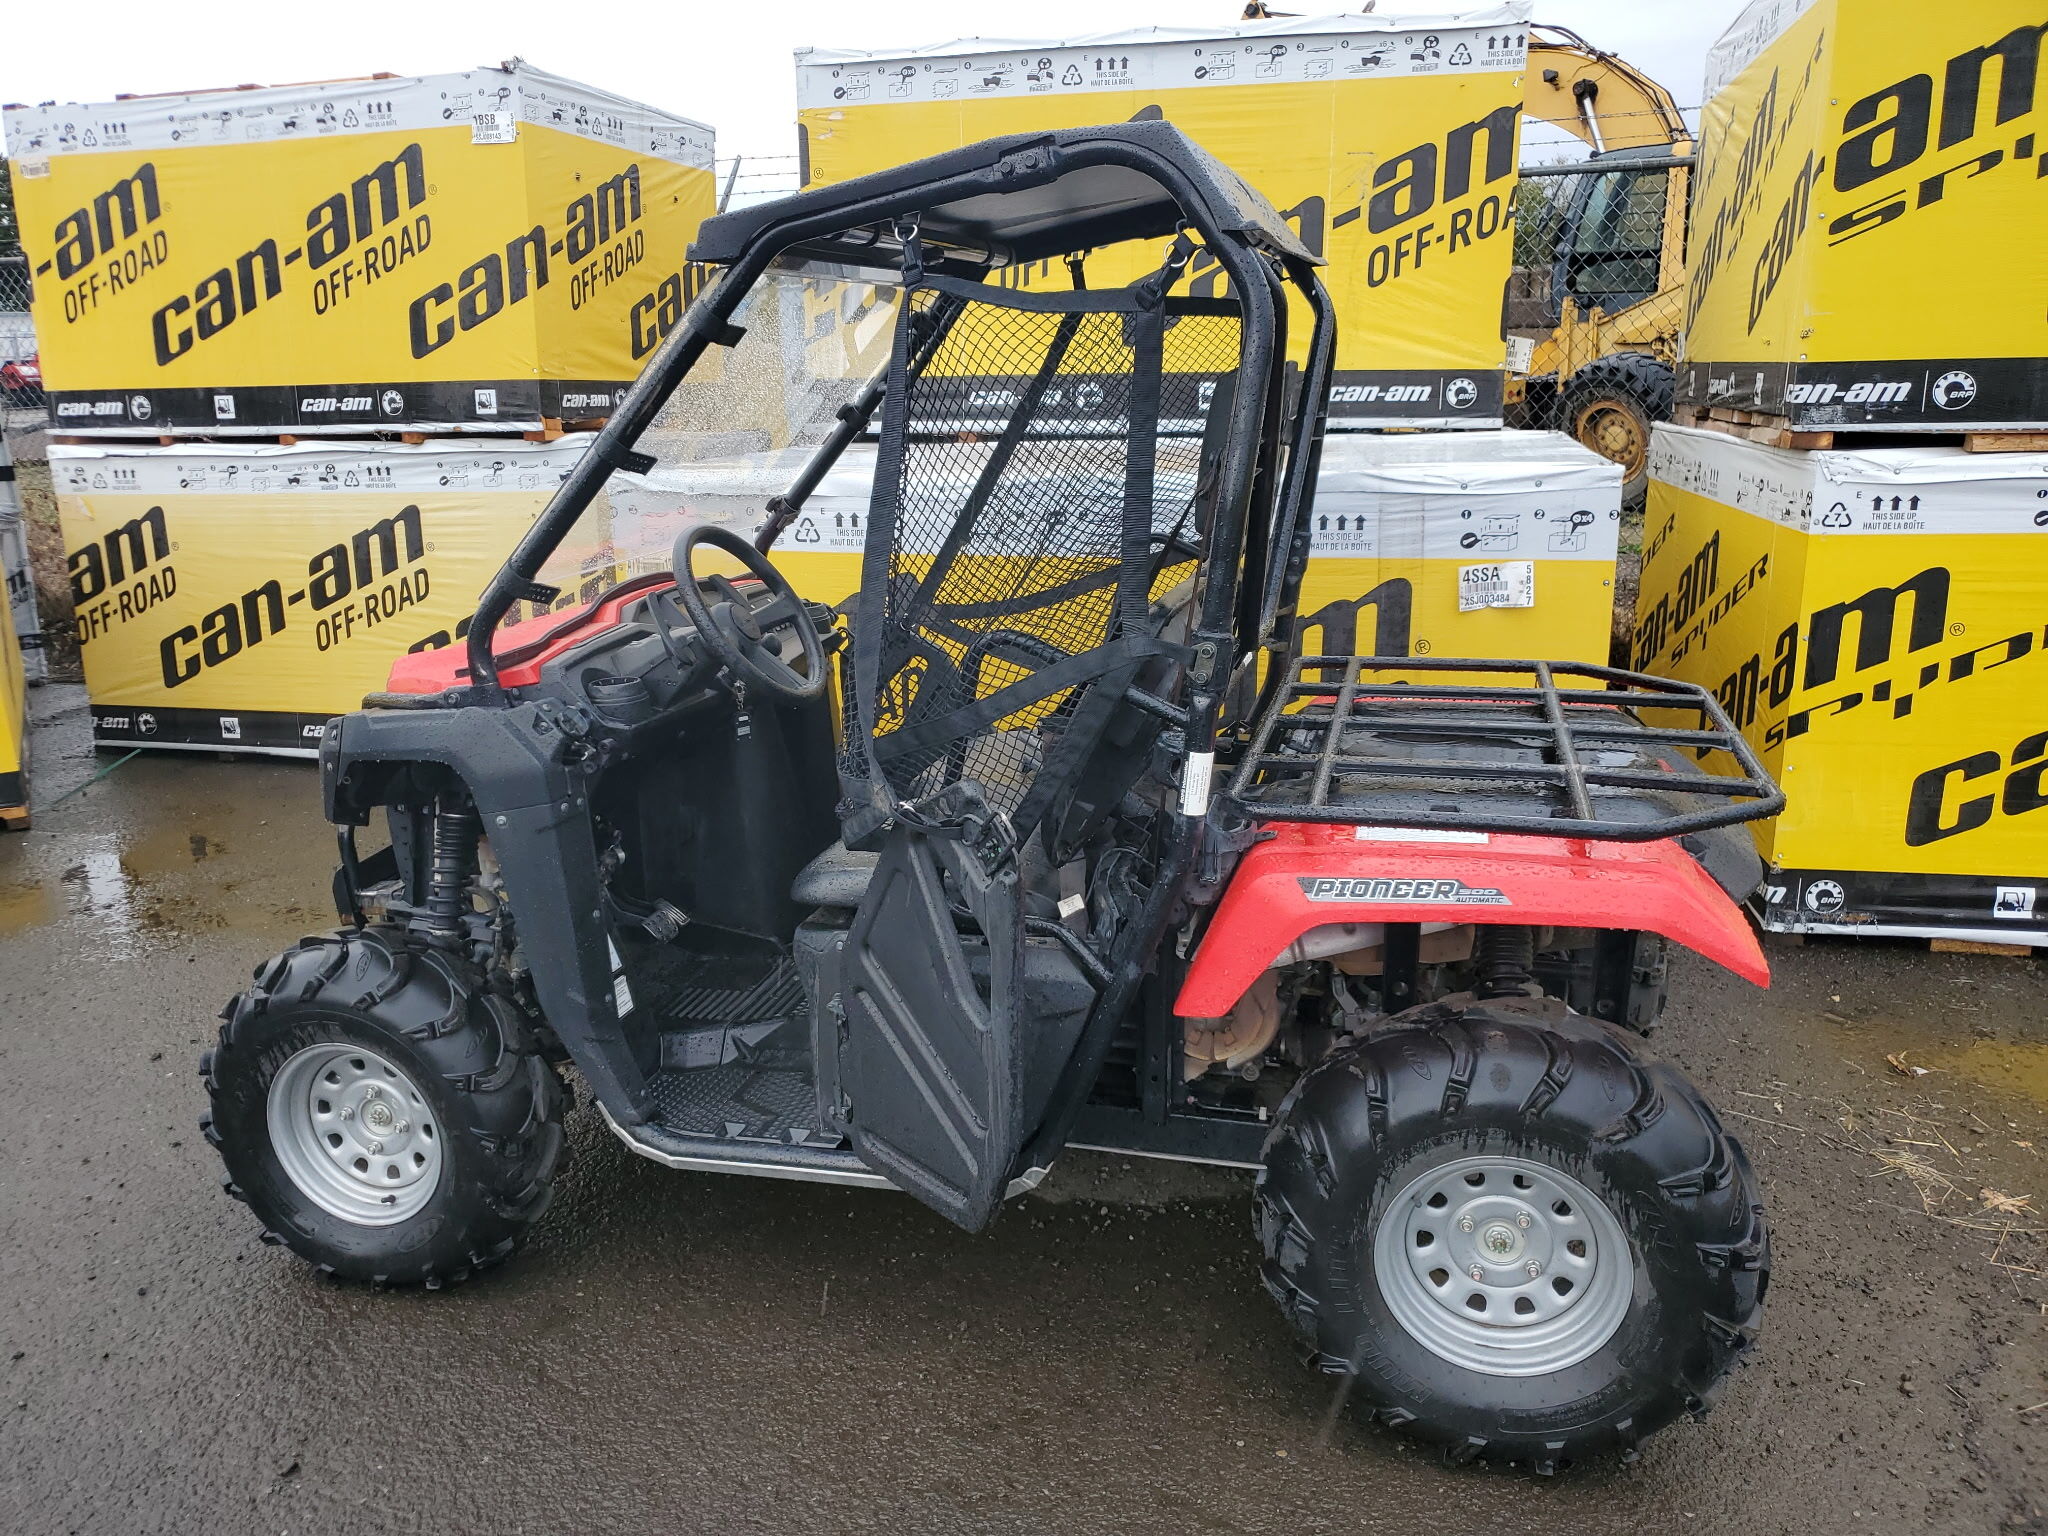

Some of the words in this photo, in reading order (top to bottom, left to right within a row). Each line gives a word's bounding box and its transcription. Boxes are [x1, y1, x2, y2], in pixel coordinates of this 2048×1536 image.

[152, 143, 427, 367] can-am
[409, 164, 641, 360] can-am
[313, 214, 432, 316] OFF-ROAD
[571, 229, 644, 311] OFF-ROAD
[64, 230, 169, 324] OFF-ROAD
[562, 394, 610, 408] can-am
[1329, 385, 1431, 402] can-am
[1787, 382, 1911, 403] can-am
[1950, 391, 1974, 399] BRP
[57, 401, 124, 416] can-am
[301, 395, 373, 413] can-am
[1863, 522, 1881, 530] HAUT
[1882, 522, 1892, 530] DE
[1893, 522, 1902, 530] LA
[1904, 519, 1925, 530] BOÎTE
[1871, 512, 1888, 520] THIS
[1889, 512, 1906, 520] SIDE
[1907, 512, 1917, 520] UP
[836, 528, 851, 537] THIS
[852, 528, 865, 537] SIDE
[1318, 532, 1335, 541] THIS
[1336, 532, 1351, 541] SIDE
[1353, 532, 1363, 541] UP
[830, 538, 844, 546] HAUT
[846, 538, 854, 546] DE
[1311, 542, 1327, 550] HAUT
[1329, 542, 1339, 550] DE
[1341, 542, 1349, 550] LA
[1351, 539, 1372, 550] BOÎTE
[1462, 566, 1501, 584] 4SSA
[77, 566, 177, 646] OFF-ROAD
[160, 505, 424, 689] can-am
[316, 568, 430, 651] OFF-ROAD
[1671, 553, 1768, 669] SPYDER
[1312, 879, 1459, 900] PIONEER
